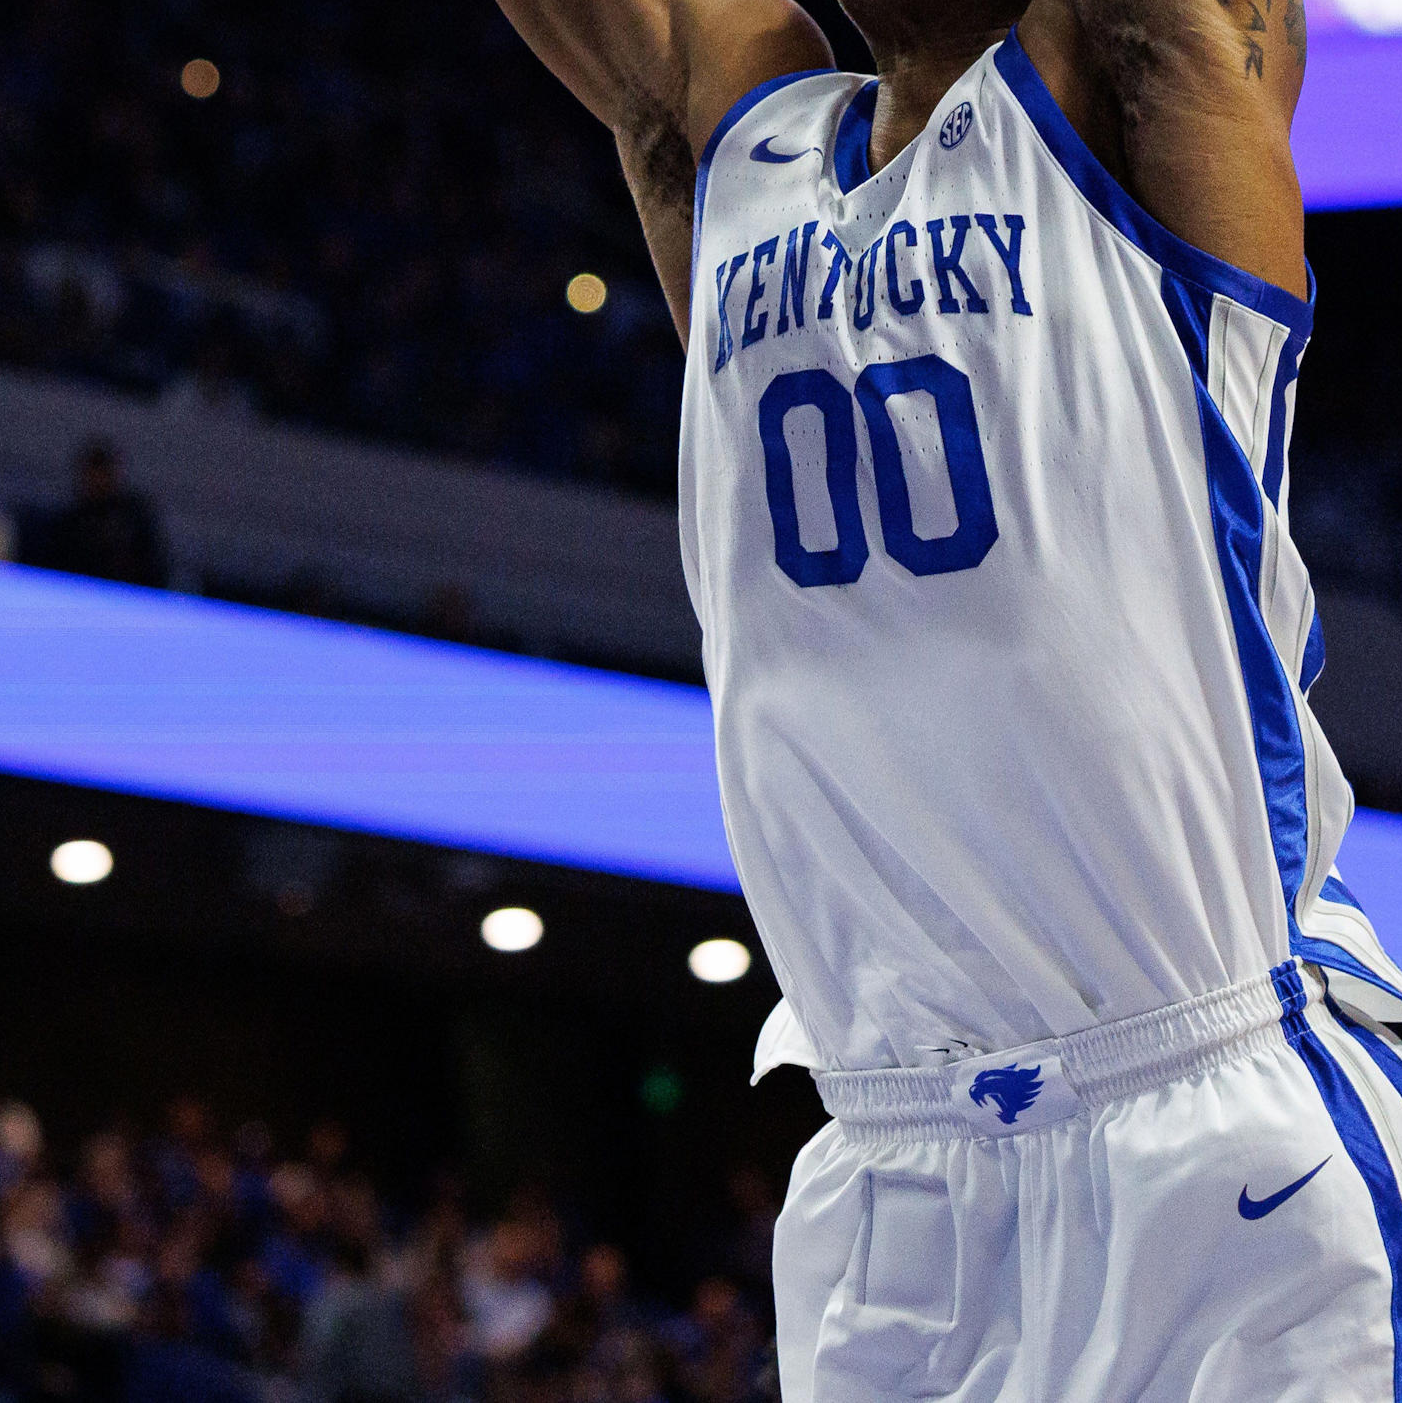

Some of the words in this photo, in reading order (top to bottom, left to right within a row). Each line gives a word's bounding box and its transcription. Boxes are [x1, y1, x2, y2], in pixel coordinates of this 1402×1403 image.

[940, 102, 971, 147] SEC
[713, 213, 1033, 375] KENTUCKY
[758, 353, 999, 588] 00
